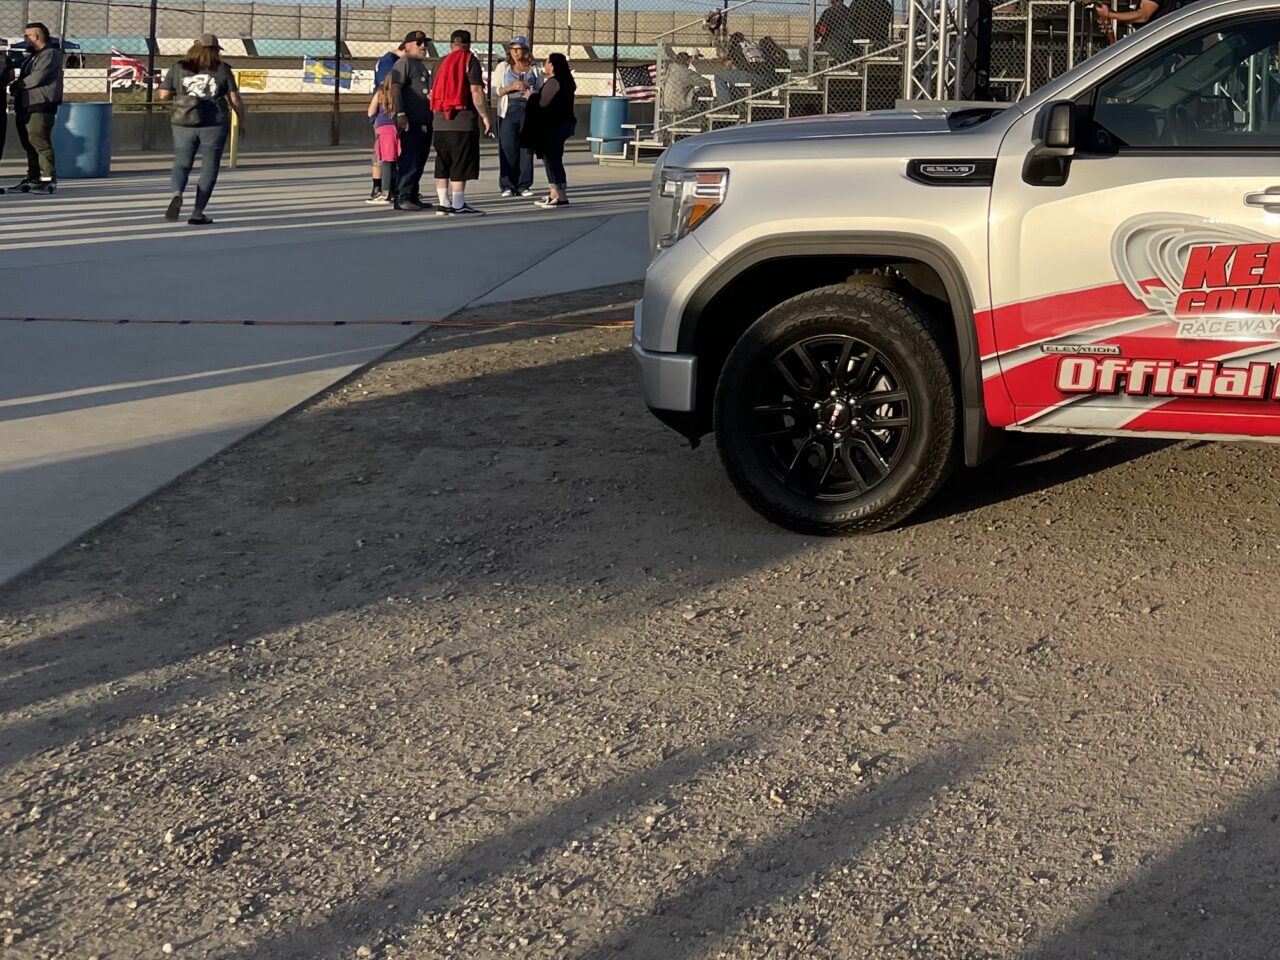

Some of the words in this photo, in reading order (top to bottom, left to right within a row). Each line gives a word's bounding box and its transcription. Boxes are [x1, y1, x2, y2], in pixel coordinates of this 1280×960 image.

[1180, 318, 1280, 335] RACEWAY
[1046, 341, 1117, 353] ELEVATION
[1056, 356, 1270, 400] Official
